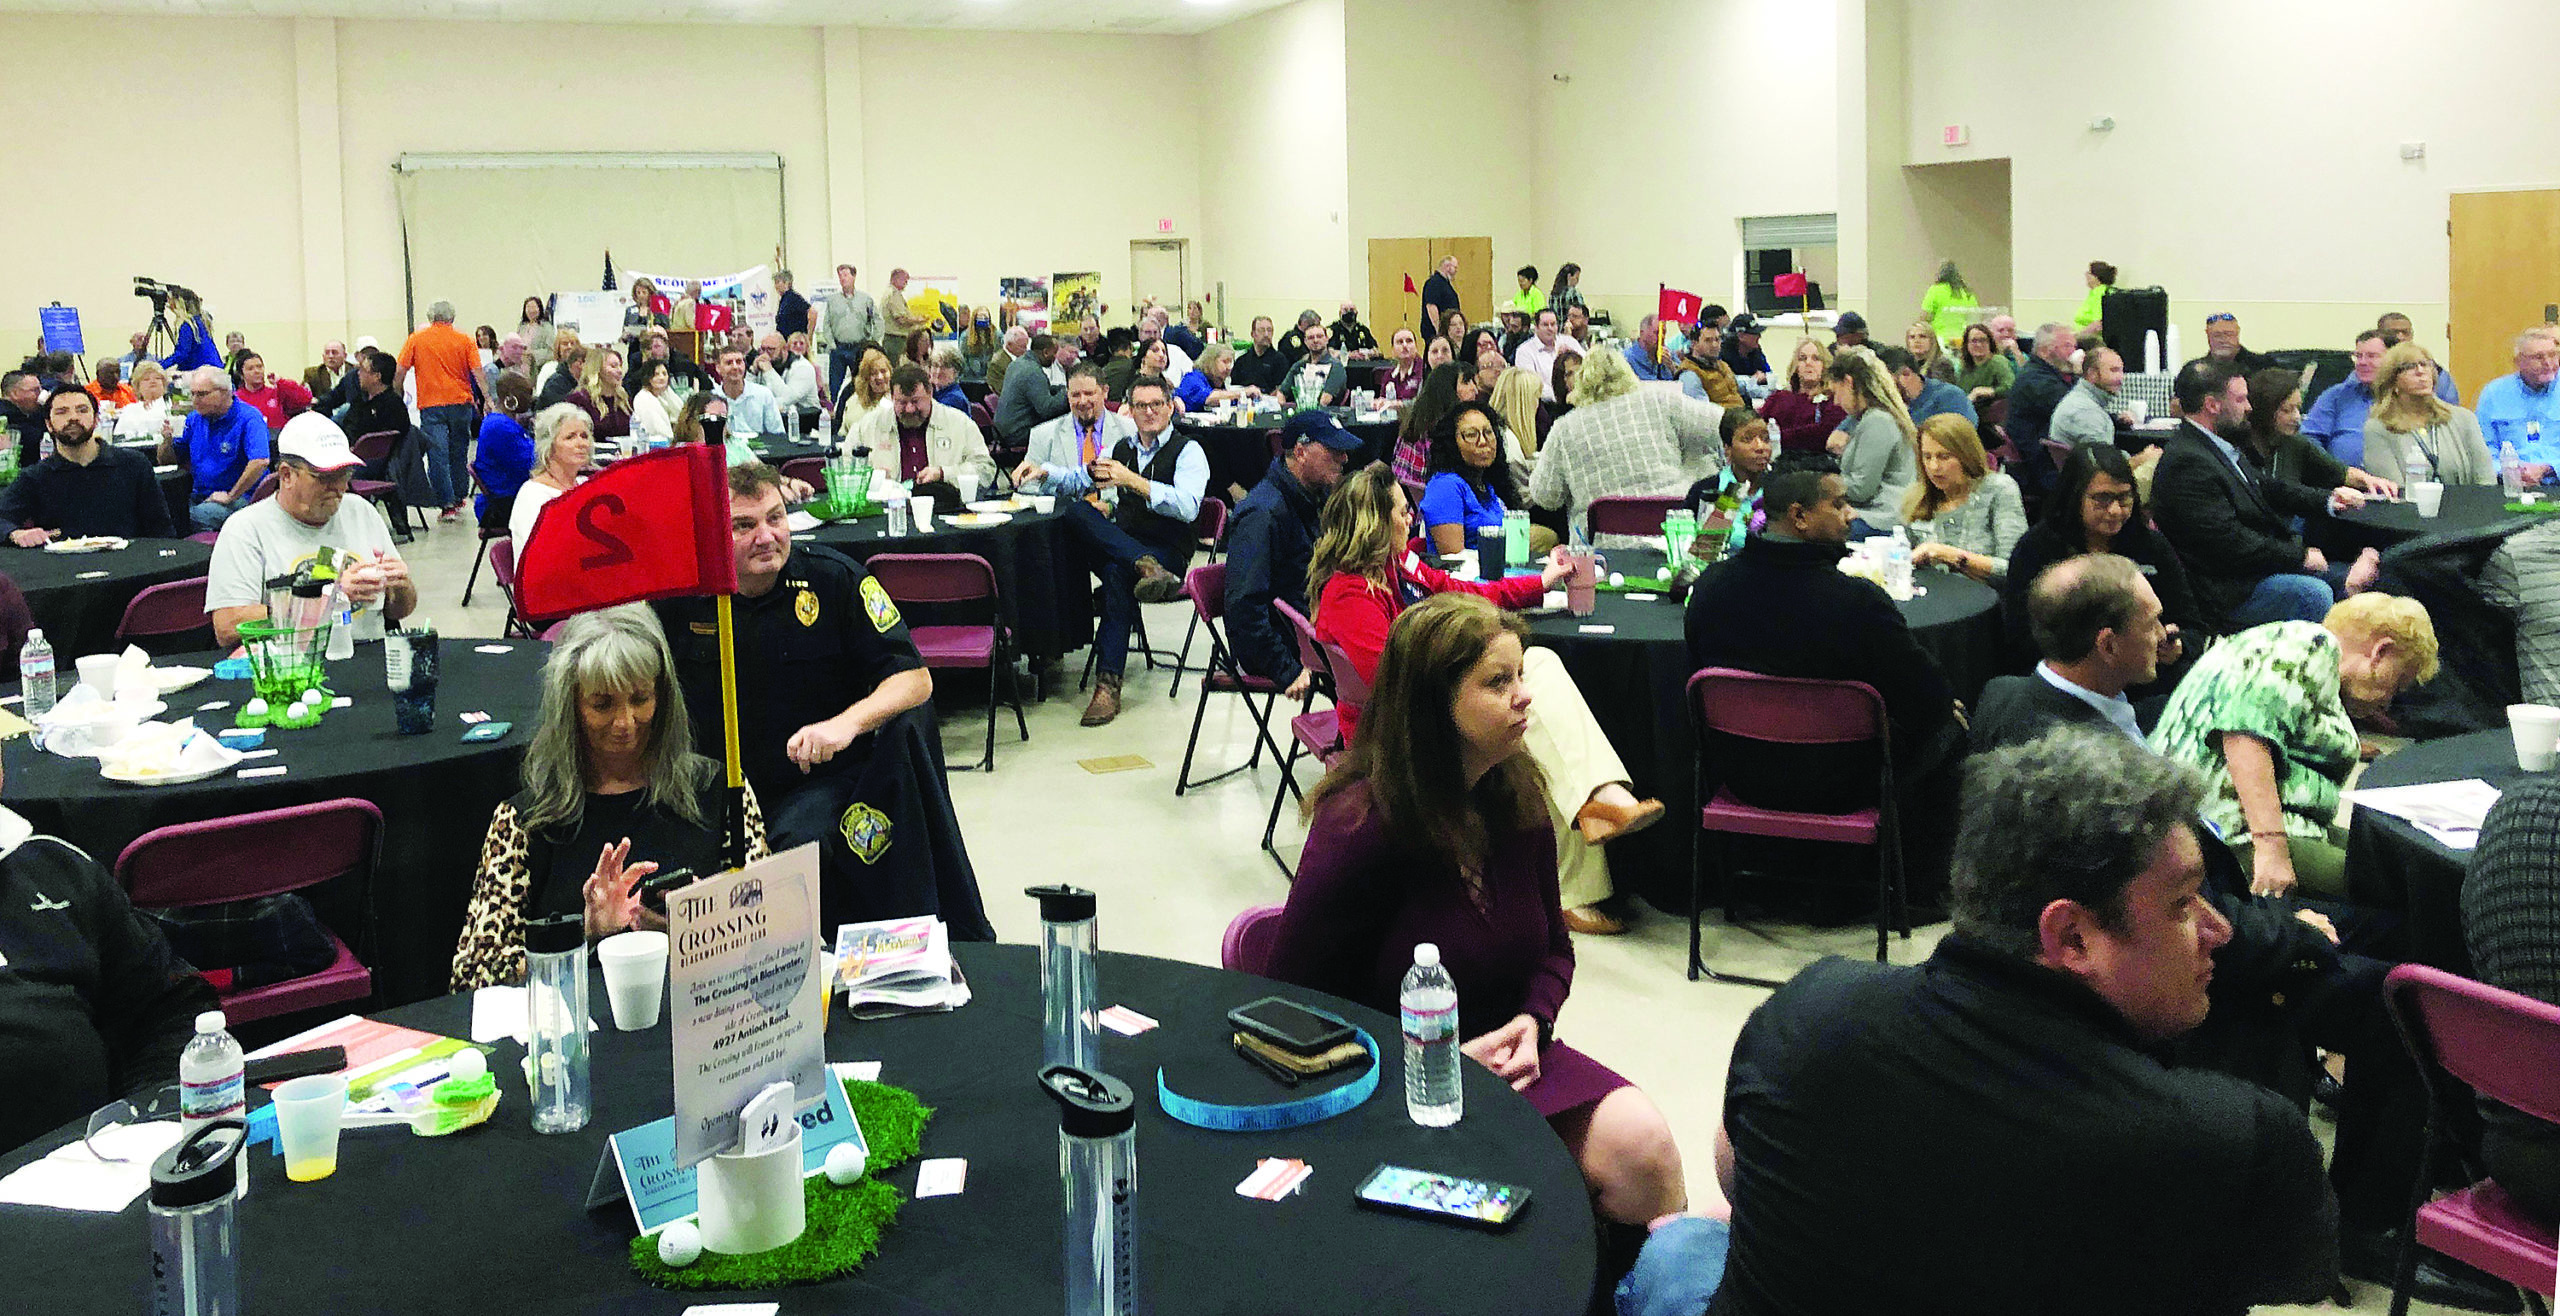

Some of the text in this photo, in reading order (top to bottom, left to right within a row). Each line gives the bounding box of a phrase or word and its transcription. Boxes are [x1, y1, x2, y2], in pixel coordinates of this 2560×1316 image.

[710, 309, 721, 326] 7
[1677, 298, 1688, 317] 4
[678, 908, 767, 956] CROSSING
[680, 942, 728, 968] BLACKWATER
[694, 956, 804, 1007] The Crossing at Blackwater,
[712, 1034, 736, 1051] 4927
[738, 1019, 768, 1041] Antioch
